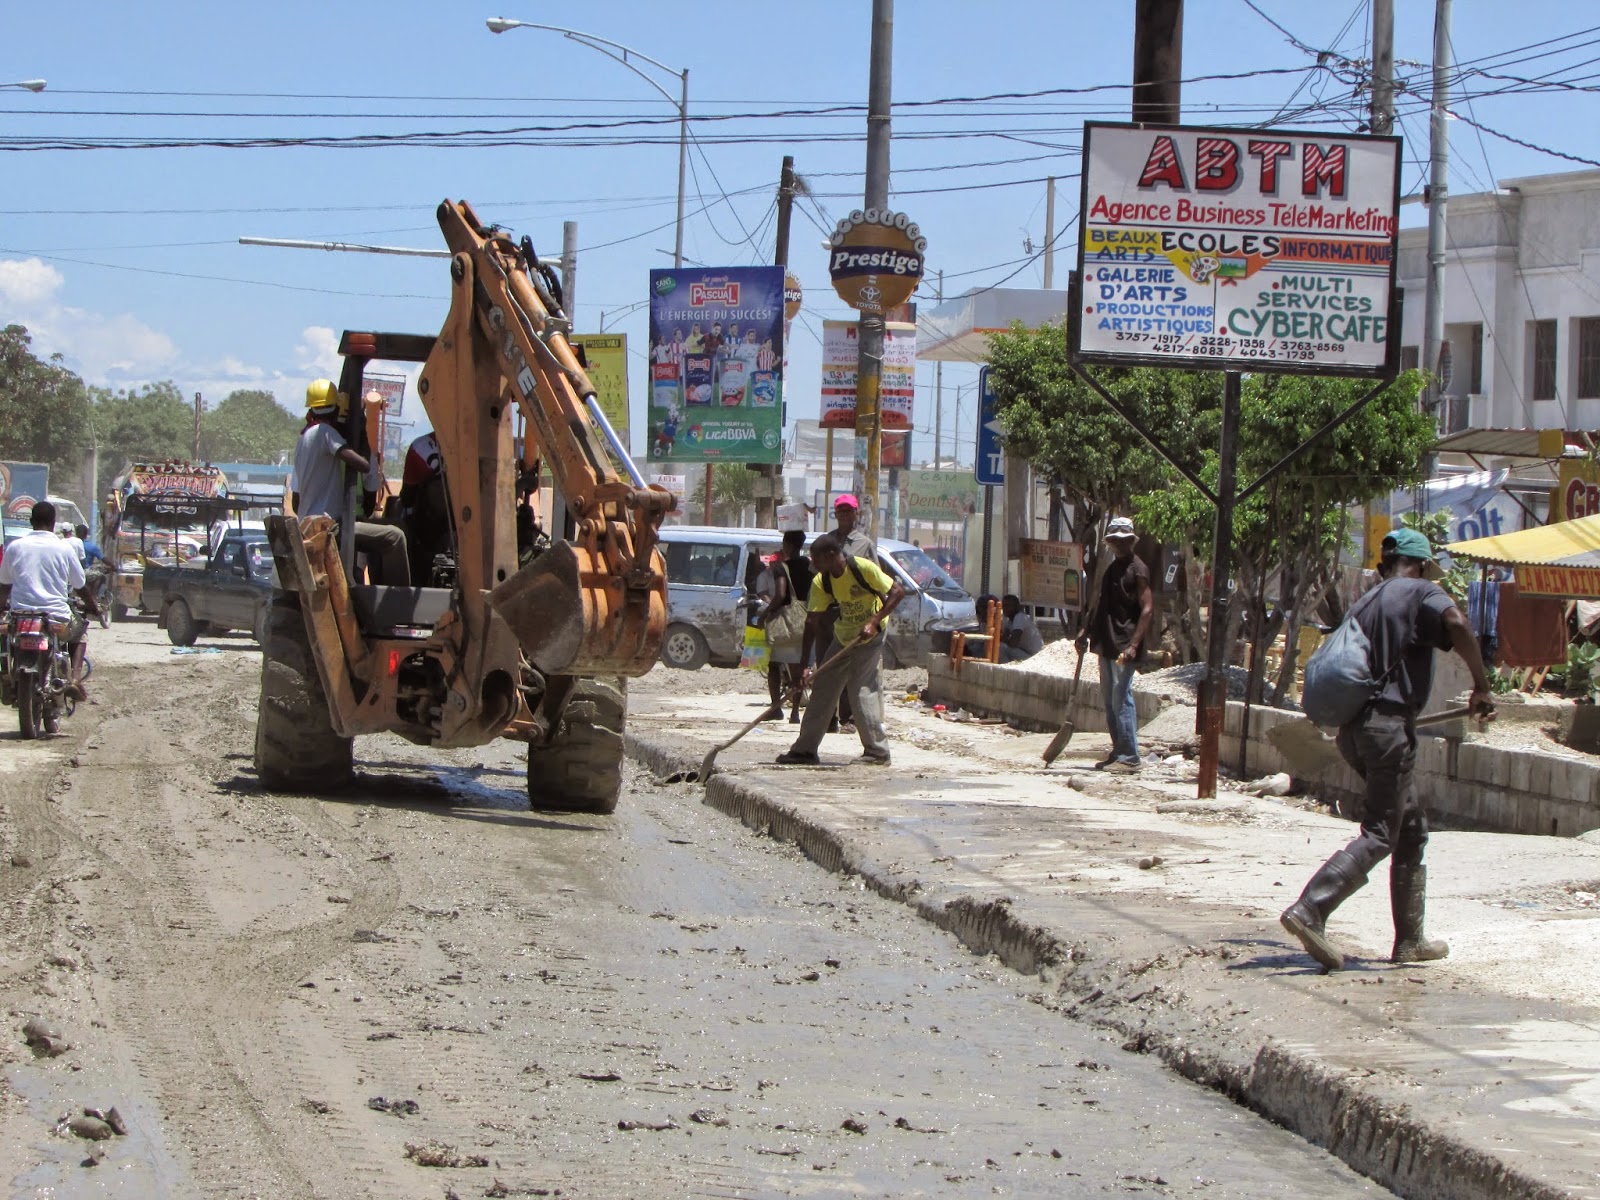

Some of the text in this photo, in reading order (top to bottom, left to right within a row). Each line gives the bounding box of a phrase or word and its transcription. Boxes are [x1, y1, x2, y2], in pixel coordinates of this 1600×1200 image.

[1136, 135, 1348, 199] ABTM
[1090, 194, 1171, 225] Agence
[1176, 200, 1266, 225] Business
[1090, 229, 1158, 244] BEAUX
[1160, 231, 1281, 258] ECOLES
[1096, 246, 1155, 262] ARTS
[1283, 241, 1393, 263] INFORMATIQUE
[832, 250, 919, 274] Prestige
[1096, 267, 1175, 283] GALERIE
[1281, 275, 1353, 293] MULTI
[693, 286, 737, 304] PASCUAL
[784, 290, 801, 301] stige
[1100, 284, 1187, 302] D'ARTS
[1256, 291, 1373, 312] SERVICES
[856, 301, 881, 310] TOYOTA
[1096, 302, 1214, 317] PRODUCTIONS
[714, 310, 727, 320] DU
[1097, 317, 1213, 334] ARTISTIQUES
[1115, 331, 1182, 344] 3757-1917
[1199, 336, 1266, 349] 3228-1358
[1280, 340, 1345, 352] 3763-8569
[1152, 343, 1224, 356] 4217-8083
[1240, 348, 1316, 360] 4043-1795
